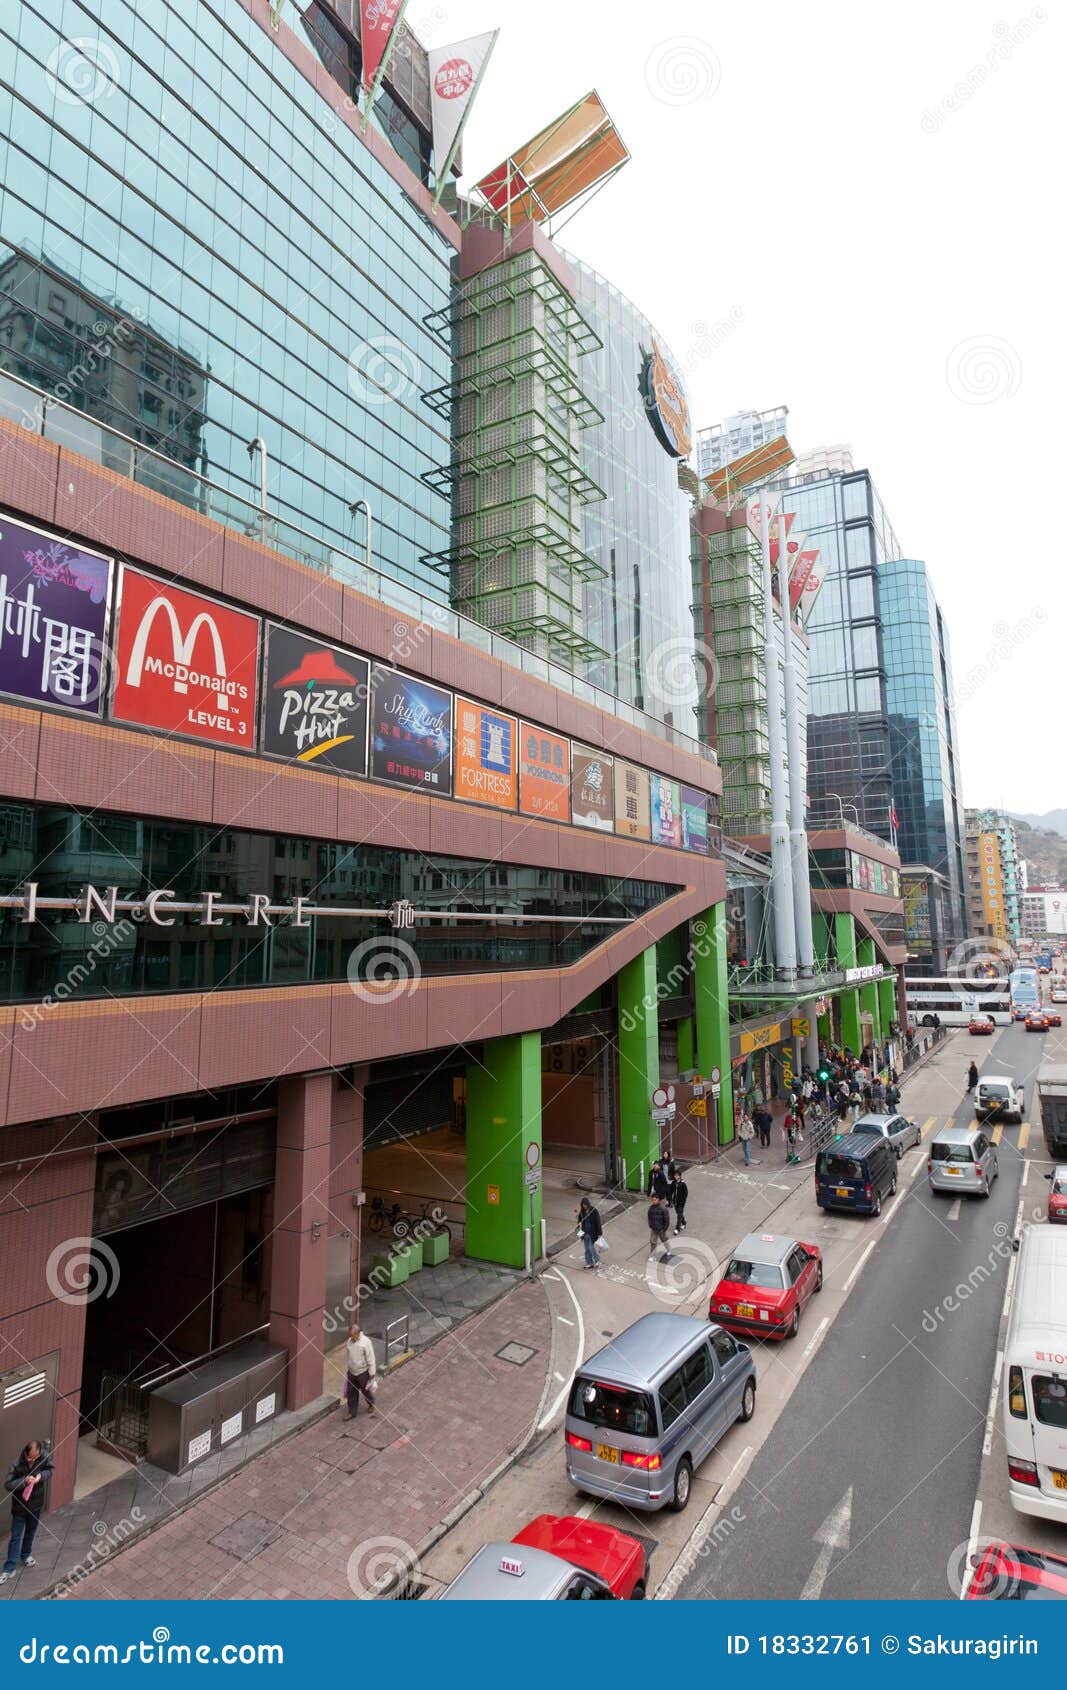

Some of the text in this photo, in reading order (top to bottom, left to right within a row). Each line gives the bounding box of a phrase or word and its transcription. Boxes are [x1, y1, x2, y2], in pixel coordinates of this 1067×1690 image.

[145, 656, 249, 700] McDonald's
[188, 709, 248, 735] LEVEL 3
[293, 713, 348, 750] Hut
[461, 767, 512, 797] FORTRESS
[501, 1559, 519, 1574] TAXI
